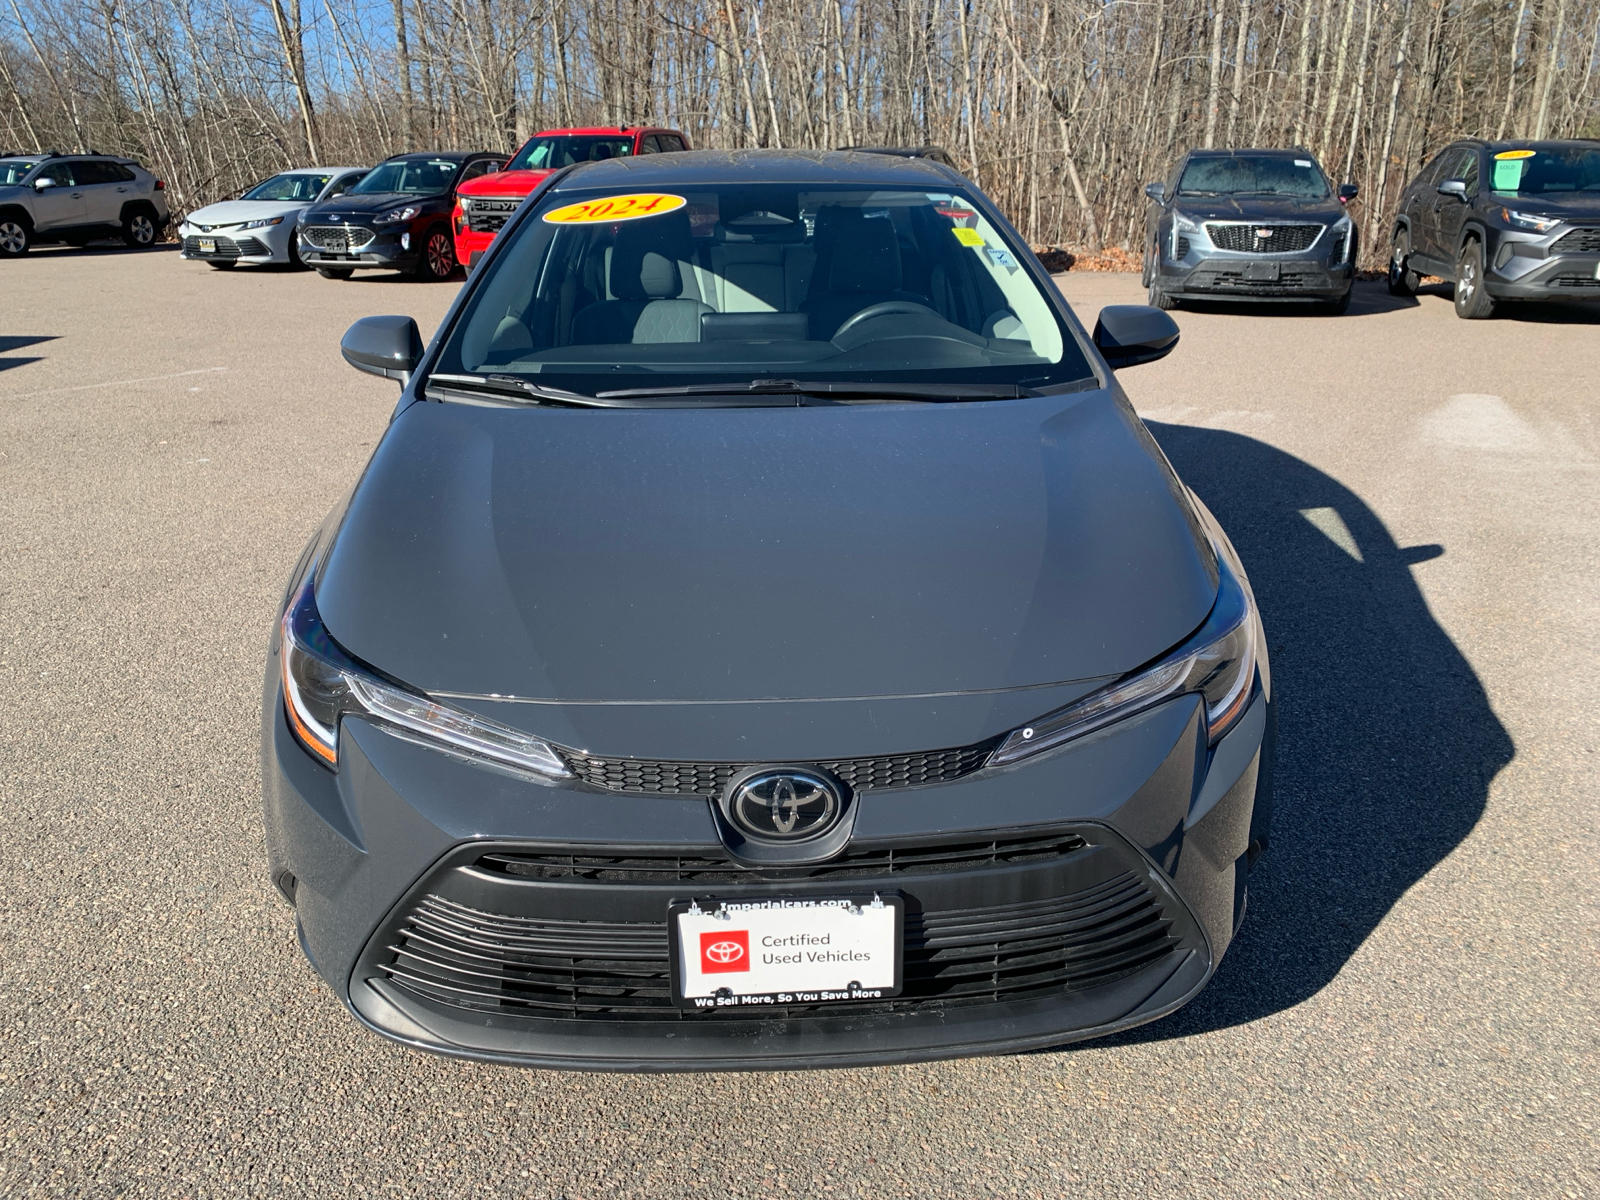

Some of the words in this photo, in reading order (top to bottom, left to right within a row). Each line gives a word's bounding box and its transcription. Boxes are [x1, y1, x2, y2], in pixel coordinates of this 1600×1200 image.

[563, 196, 665, 221] 2024
[720, 899, 852, 911] Imperialcars.com
[761, 933, 831, 947] Certified
[762, 952, 802, 964] Used
[806, 950, 871, 963] Vehicles
[695, 998, 714, 1007] We
[717, 997, 738, 1006] Sell
[742, 994, 774, 1004] More,
[777, 993, 793, 1003] So
[796, 992, 818, 1002] You
[820, 991, 849, 1001] Save
[852, 989, 882, 999] More
